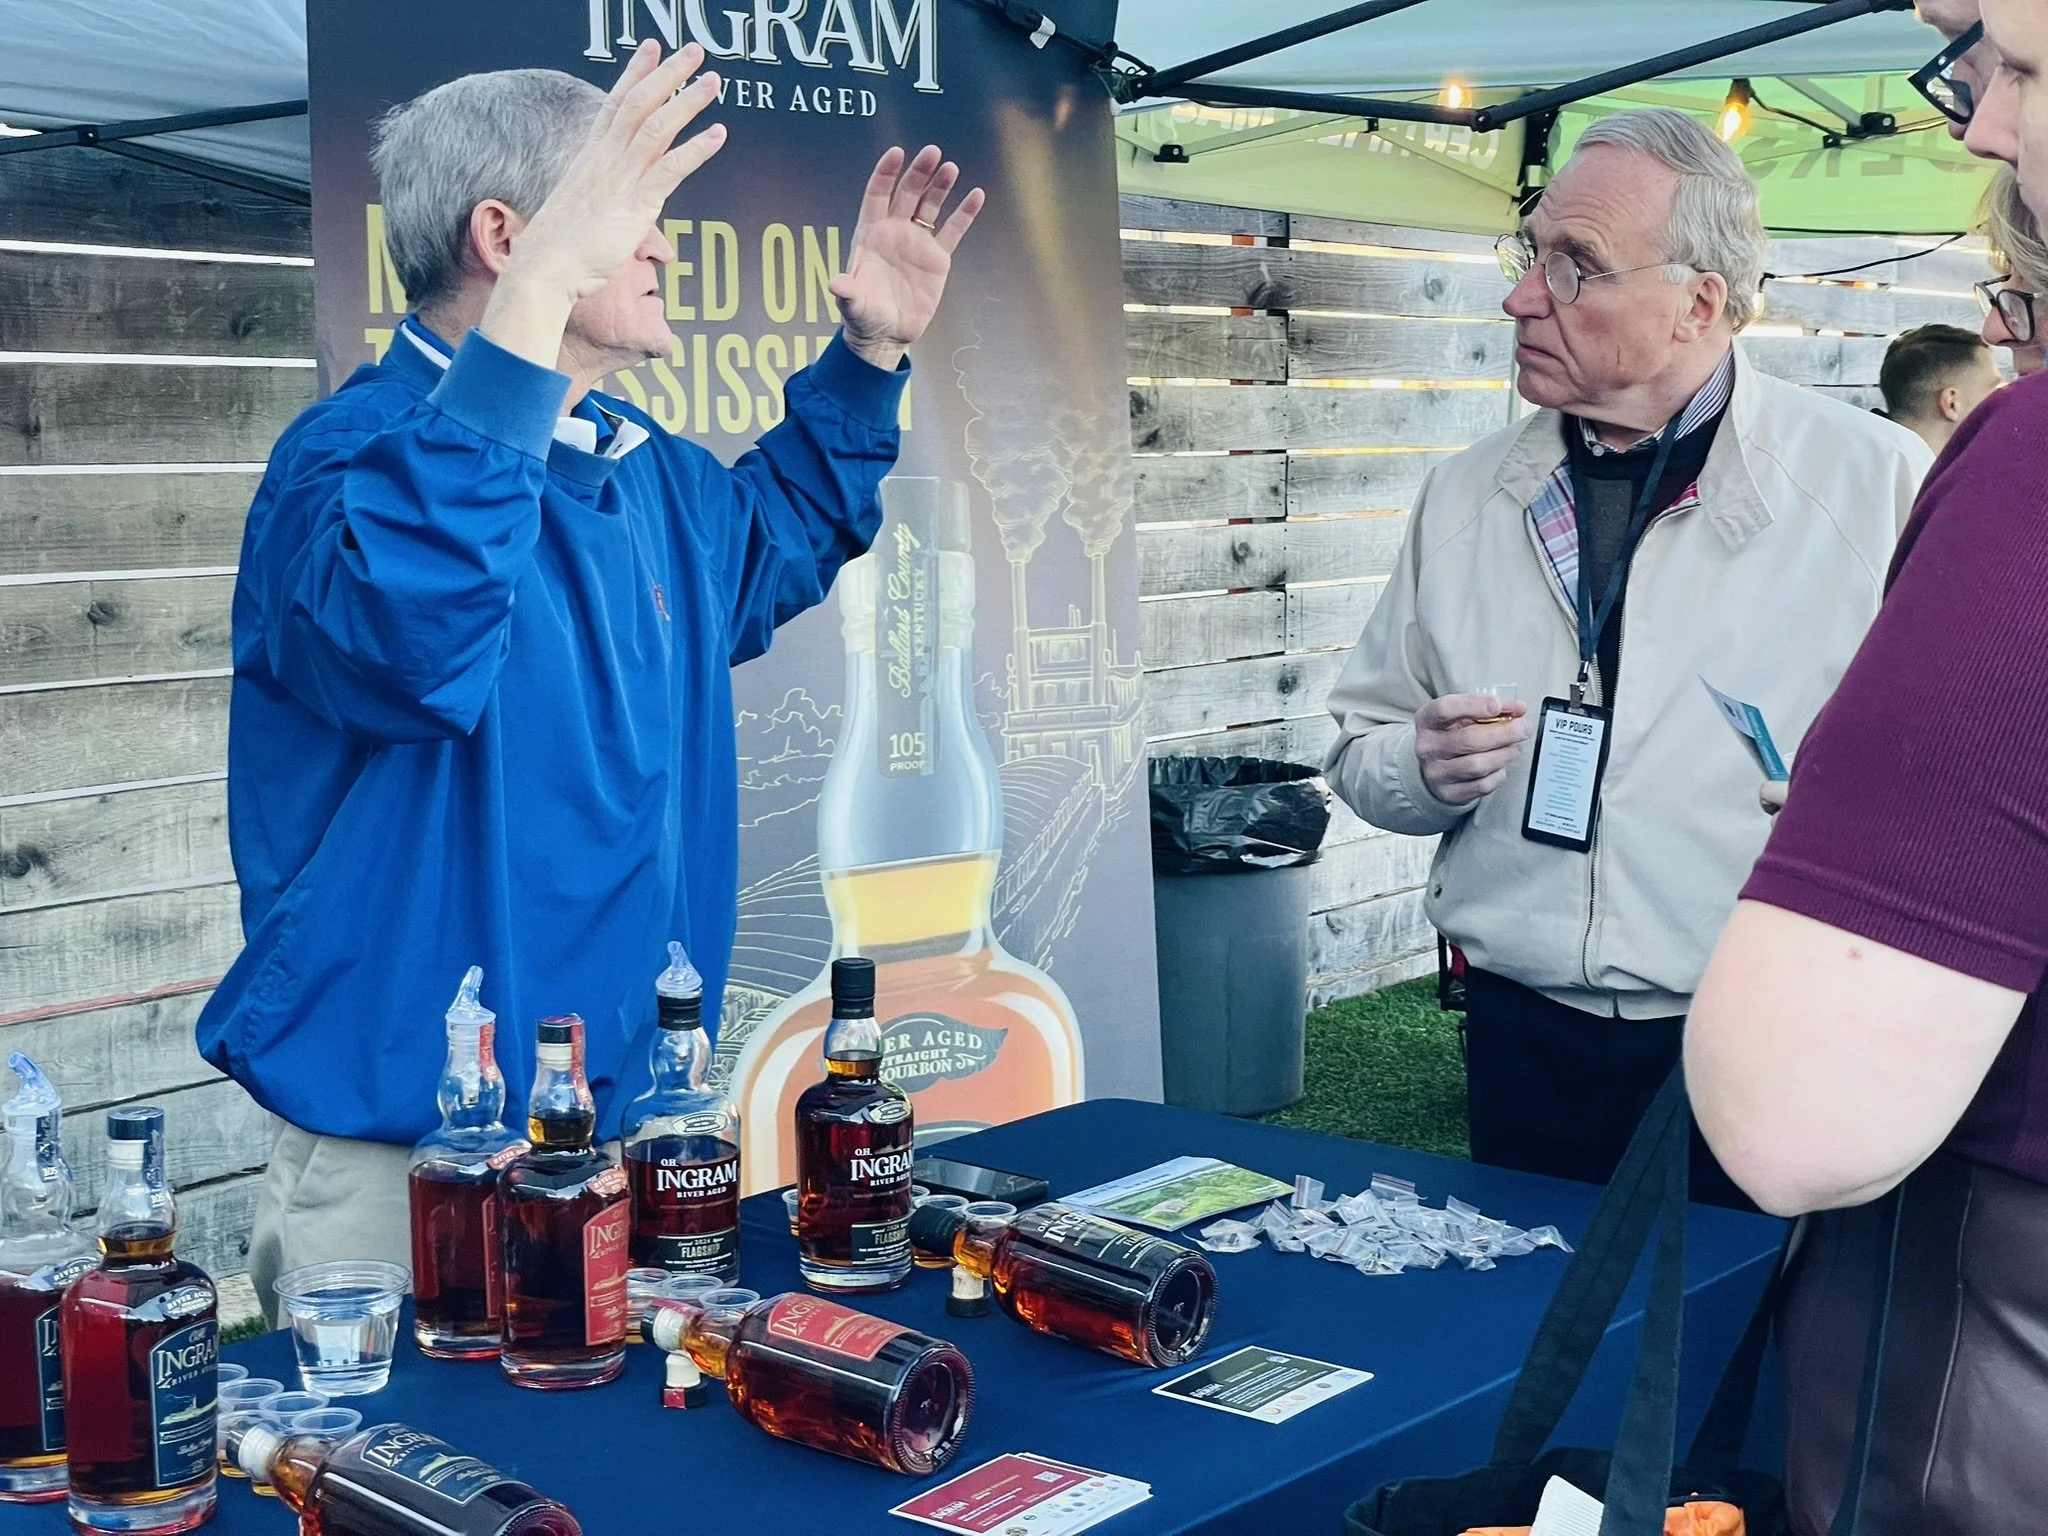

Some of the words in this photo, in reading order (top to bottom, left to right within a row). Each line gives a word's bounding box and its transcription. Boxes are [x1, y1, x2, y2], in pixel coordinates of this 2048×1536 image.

[789, 85, 877, 117] AGED
[762, 222, 842, 324] ON
[1555, 718, 1568, 730] VIP
[1568, 720, 1594, 736] POURS
[889, 732, 926, 758] 105
[890, 761, 926, 772] PROOF
[922, 1030, 984, 1050] AGED
[656, 1160, 738, 1192] INGRAM
[870, 1176, 895, 1187] RIVER
[676, 1189, 705, 1199] RIVER
[706, 1186, 727, 1196] AGED
[167, 1295, 194, 1311] RIVER
